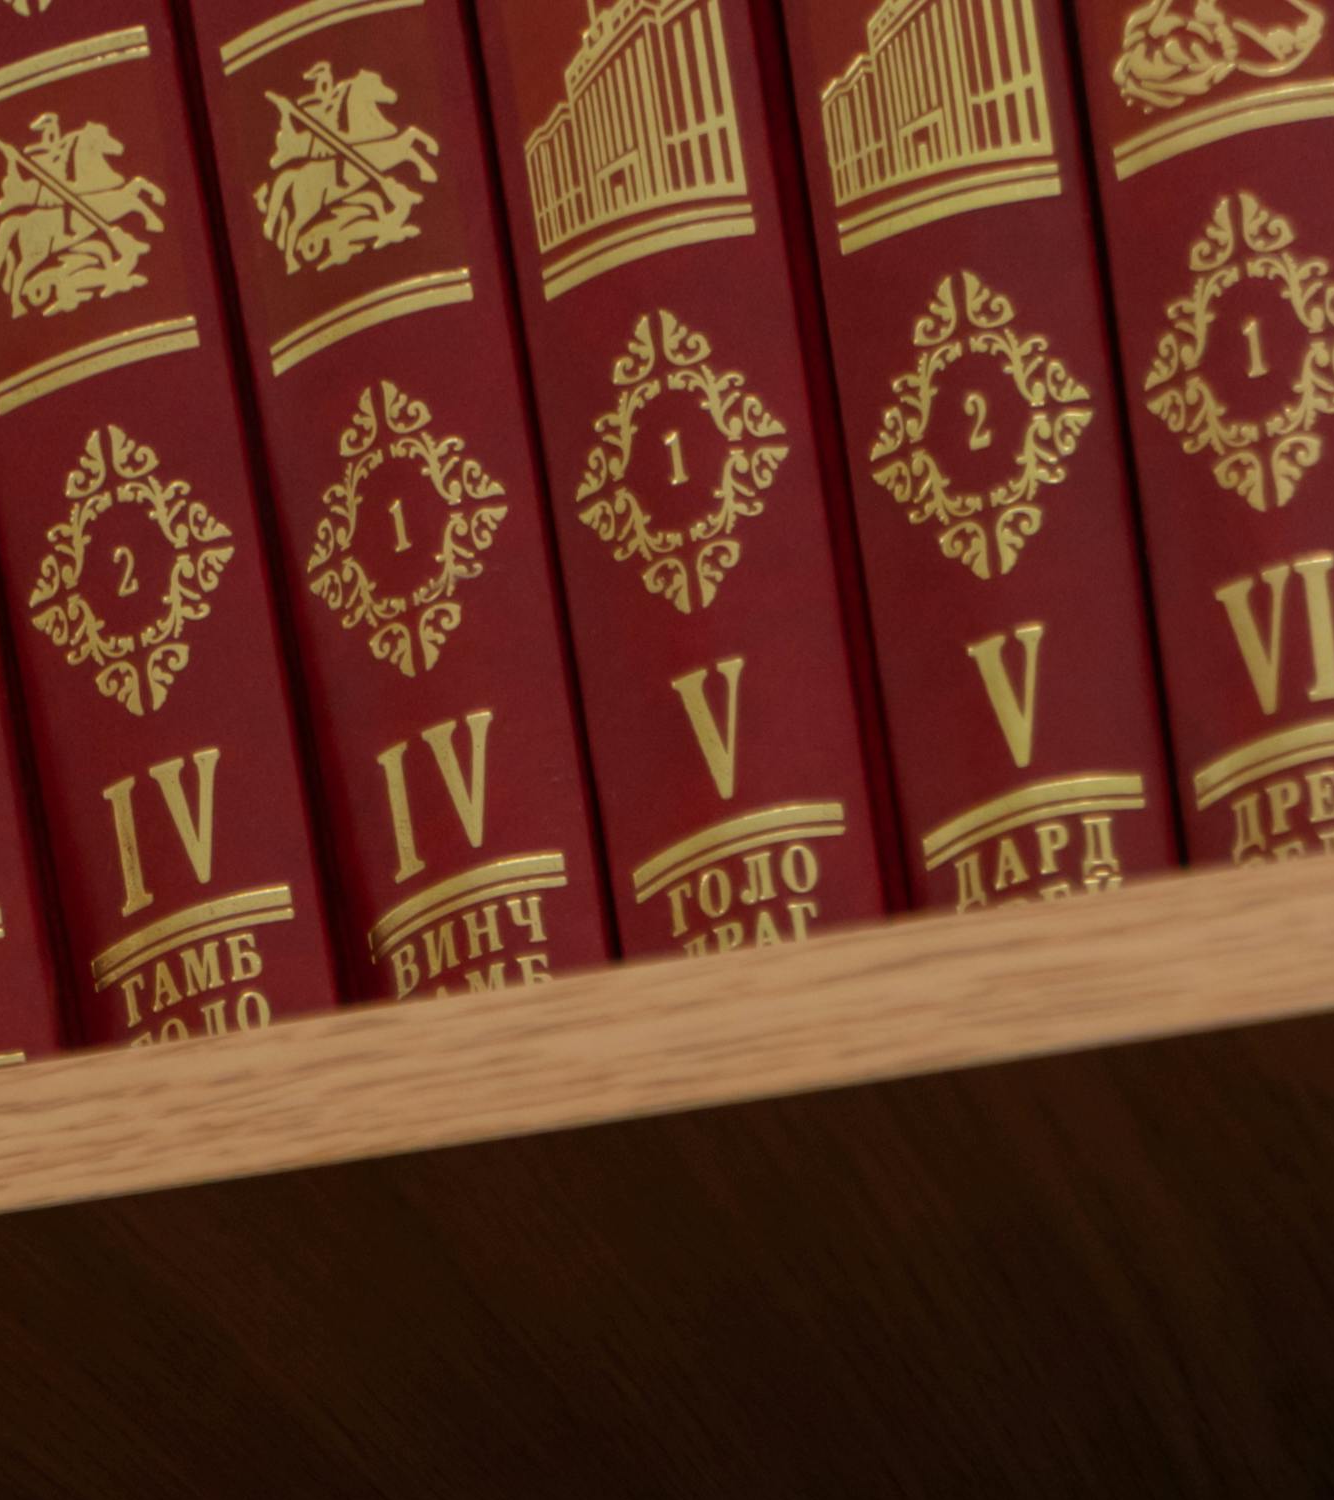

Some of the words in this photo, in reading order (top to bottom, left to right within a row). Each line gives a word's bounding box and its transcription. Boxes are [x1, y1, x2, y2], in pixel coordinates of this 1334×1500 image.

[1242, 318, 1269, 380] 1
[663, 431, 689, 486] 1
[964, 393, 993, 451] 2
[113, 546, 139, 598] 2
[389, 500, 412, 553] 1
[671, 655, 745, 800] V
[967, 621, 1045, 769] V
[102, 747, 221, 917] IV
[376, 709, 494, 885] IV
[667, 843, 820, 940] ГОЛО
[954, 815, 1121, 917] ДАРД
[121, 930, 264, 1029] ГАМБ
[391, 895, 550, 1002] ВИНЧ
